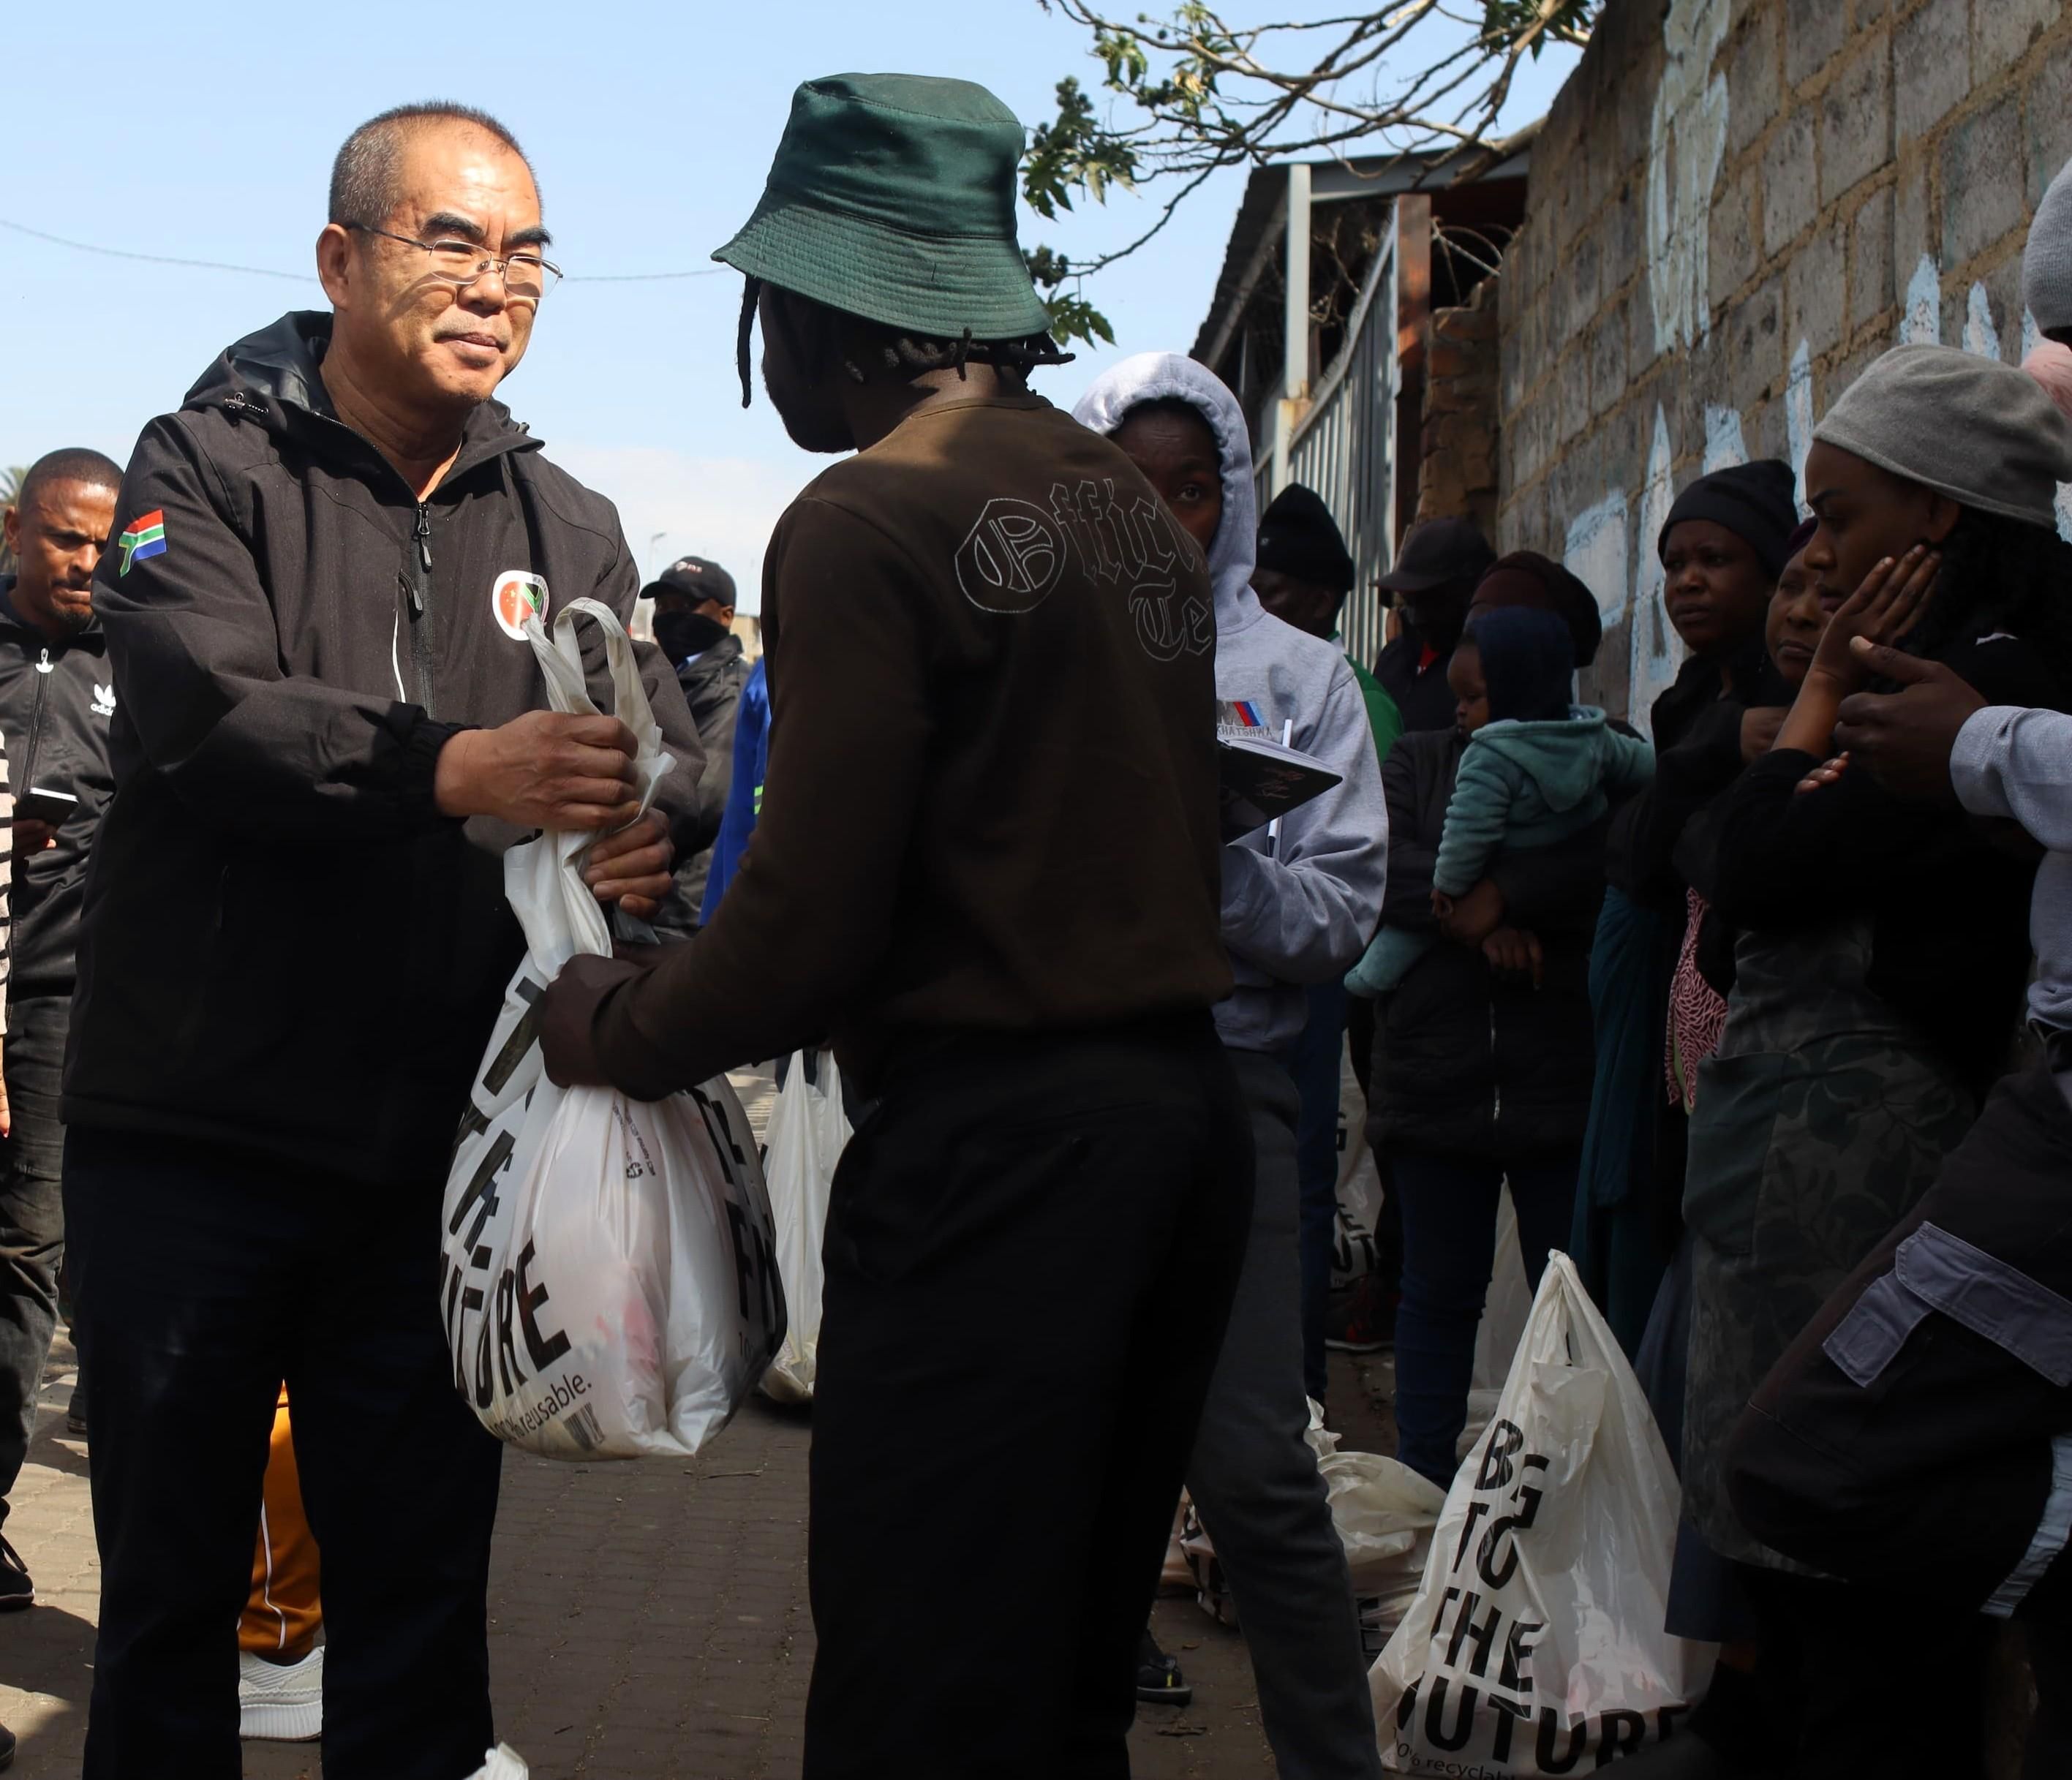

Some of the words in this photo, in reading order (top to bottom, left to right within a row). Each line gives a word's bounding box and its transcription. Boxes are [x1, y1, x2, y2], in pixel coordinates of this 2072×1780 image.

[1128, 578, 1213, 662] Te
[90, 704, 113, 717] adid
[519, 1373, 592, 1434] reusable.
[1453, 1501, 1519, 1591] TO
[1397, 1671, 1689, 1775] UTUR
